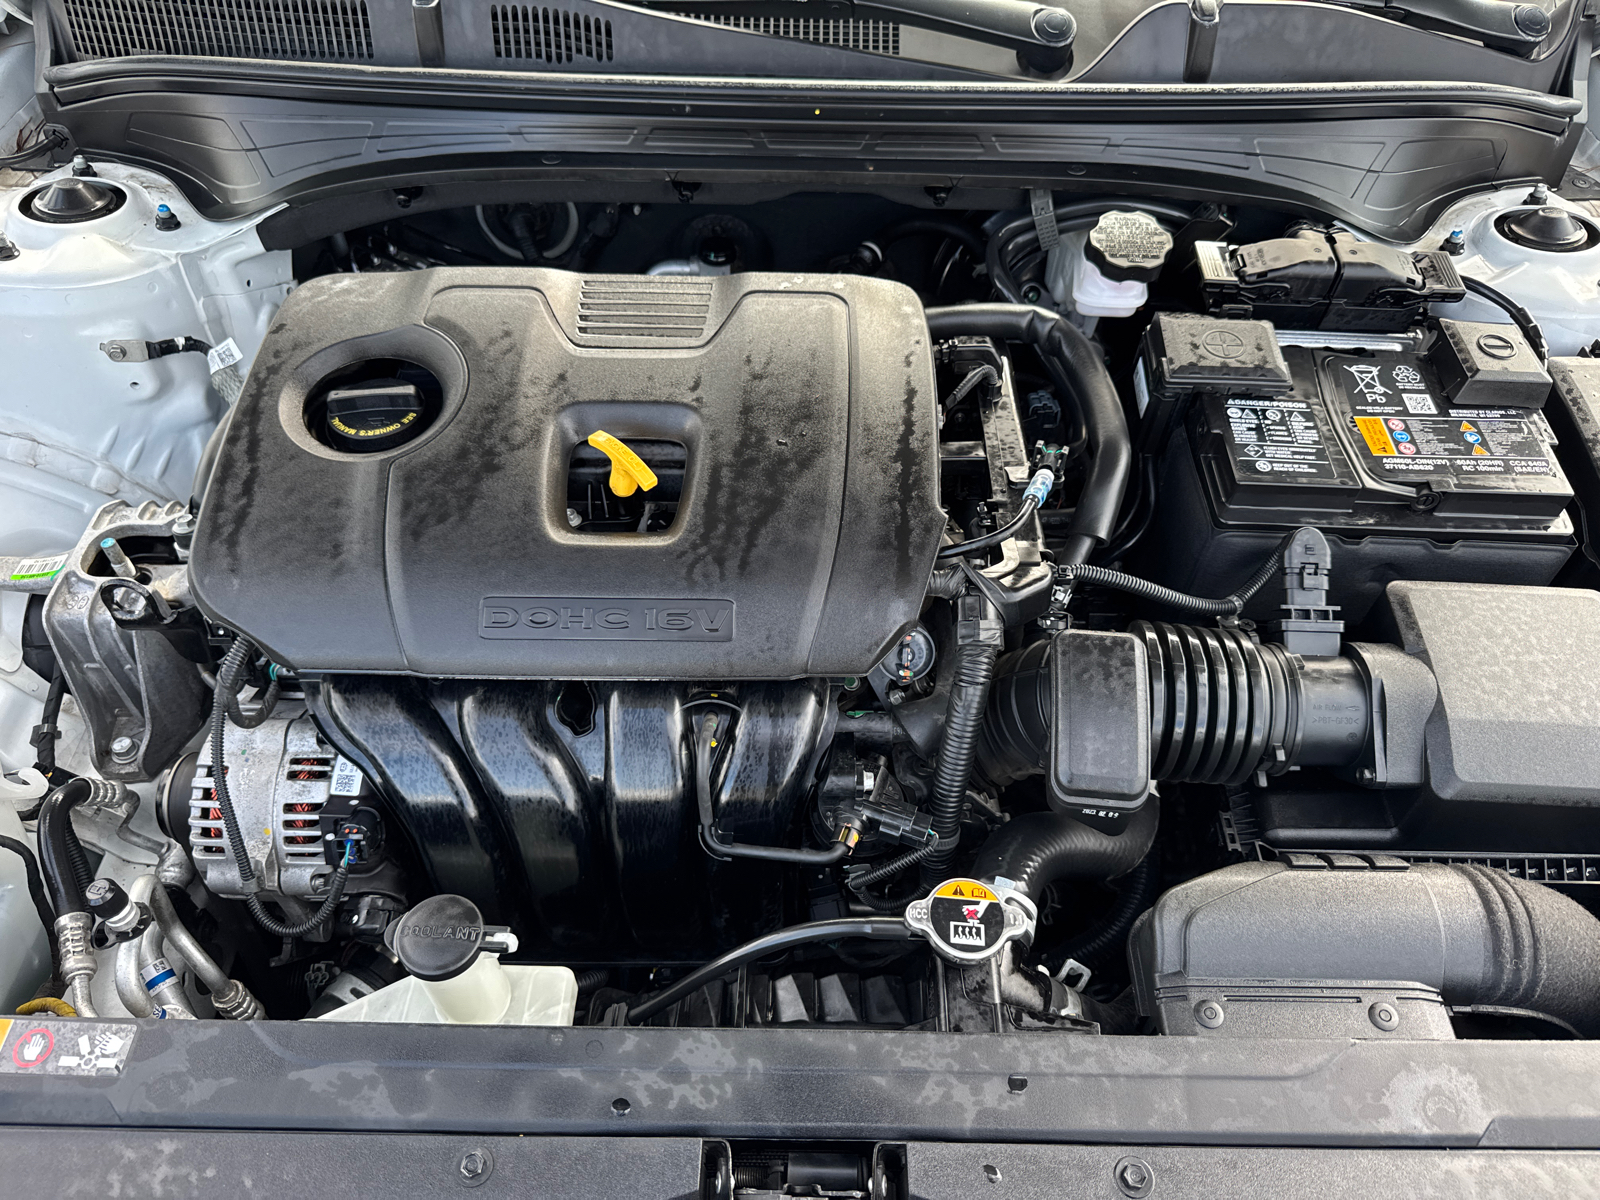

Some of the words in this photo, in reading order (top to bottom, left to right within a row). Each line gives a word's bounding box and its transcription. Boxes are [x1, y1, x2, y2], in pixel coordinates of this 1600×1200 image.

[1366, 394, 1386, 403] Pb
[401, 412, 416, 424] SEE
[331, 417, 357, 435] MANUAL
[358, 422, 400, 436] OWNER'S
[484, 606, 630, 630] DOHC
[645, 608, 730, 632] 16V
[909, 908, 928, 919] HCC
[400, 925, 480, 941] COOLANT
